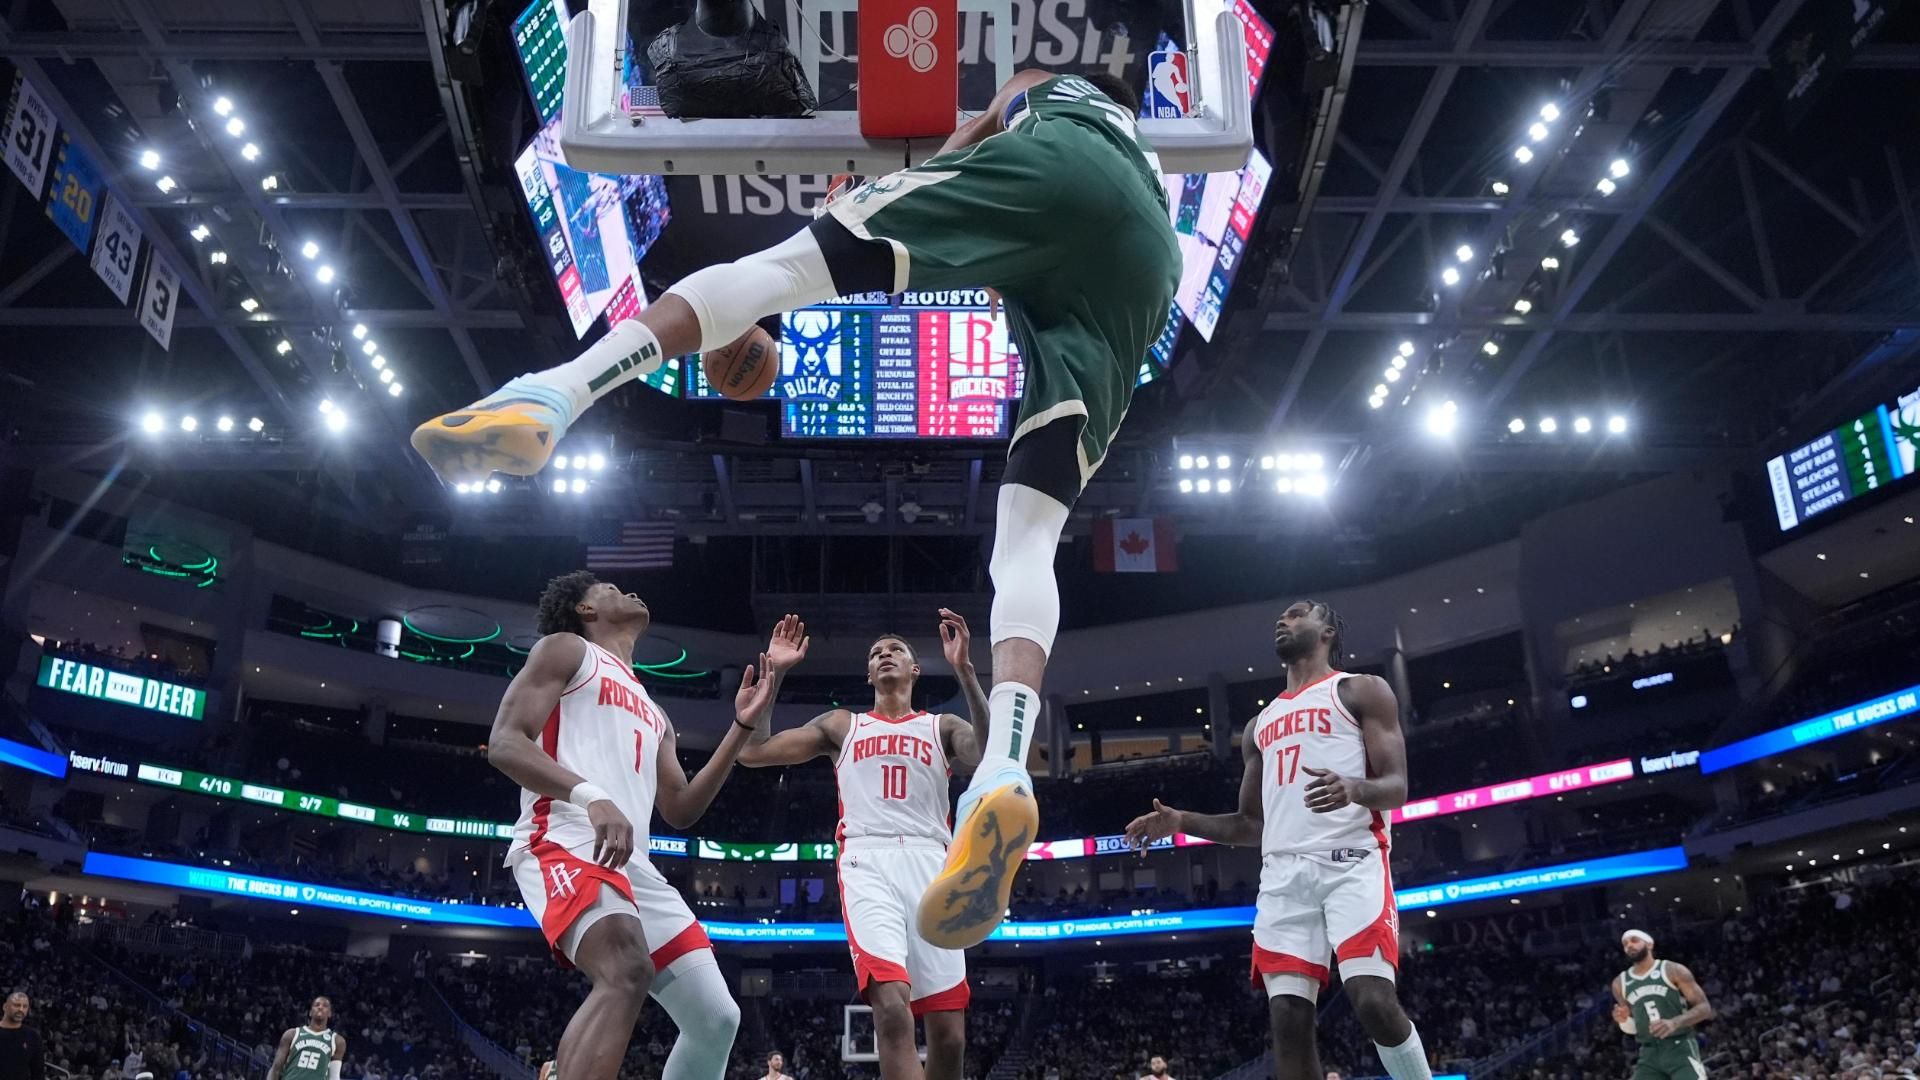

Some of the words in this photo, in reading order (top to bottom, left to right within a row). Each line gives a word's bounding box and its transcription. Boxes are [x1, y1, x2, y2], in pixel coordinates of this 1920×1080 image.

[1158, 107, 1177, 118] NBA
[16, 109, 46, 172] 31
[64, 174, 93, 223] 20
[105, 231, 132, 275] 43
[152, 279, 171, 321] 3
[902, 290, 1003, 305] HOUSTO
[853, 326, 860, 335] 1
[853, 348, 860, 357] 1
[784, 377, 840, 399] BUCKS
[951, 377, 1006, 399] ROCKETS
[1858, 433, 1867, 445] 1
[1797, 463, 1839, 489] BLOCKS
[1861, 447, 1871, 460] 1
[1802, 477, 1840, 502] STEALS
[1864, 461, 1875, 475] 2
[1805, 490, 1845, 517] ASSISTS
[1867, 475, 1878, 489] 2
[49, 658, 104, 697] FEAR
[144, 679, 195, 717] DEER
[1258, 708, 1331, 750] ROCKETS
[1832, 711, 1856, 730] THE
[1856, 699, 1898, 723] BUCKS
[1897, 693, 1916, 711] ON
[634, 729, 642, 774] 1
[853, 734, 932, 767] ROCKETS
[1276, 744, 1301, 786] 17
[881, 765, 907, 800] 10
[200, 778, 231, 794] 4/10
[300, 796, 322, 811] 3/7
[393, 814, 410, 828] 1/4
[1454, 793, 1477, 808] 2/7
[814, 844, 833, 859] 12
[228, 877, 247, 890] THE
[248, 880, 282, 897] BUCKS
[283, 885, 298, 898] ON
[317, 891, 357, 906] FANDUEL
[359, 898, 391, 910] SPORTS
[392, 902, 432, 915] NETWORK
[1460, 881, 1502, 896] FANDUEL
[1503, 875, 1538, 889] SPORTS
[1539, 868, 1586, 884] NETWORK
[709, 927, 745, 936] FANDUEL
[746, 927, 775, 937] SPORTS
[777, 927, 815, 936] NETWORK
[1002, 927, 1017, 936] THE
[1018, 926, 1046, 936] BUCKS
[1047, 925, 1059, 936] ON
[1075, 922, 1111, 932] FANDUEL
[1113, 919, 1143, 929] SPORTS
[1144, 917, 1183, 928] NETWORK
[1644, 1001, 1660, 1021] 5
